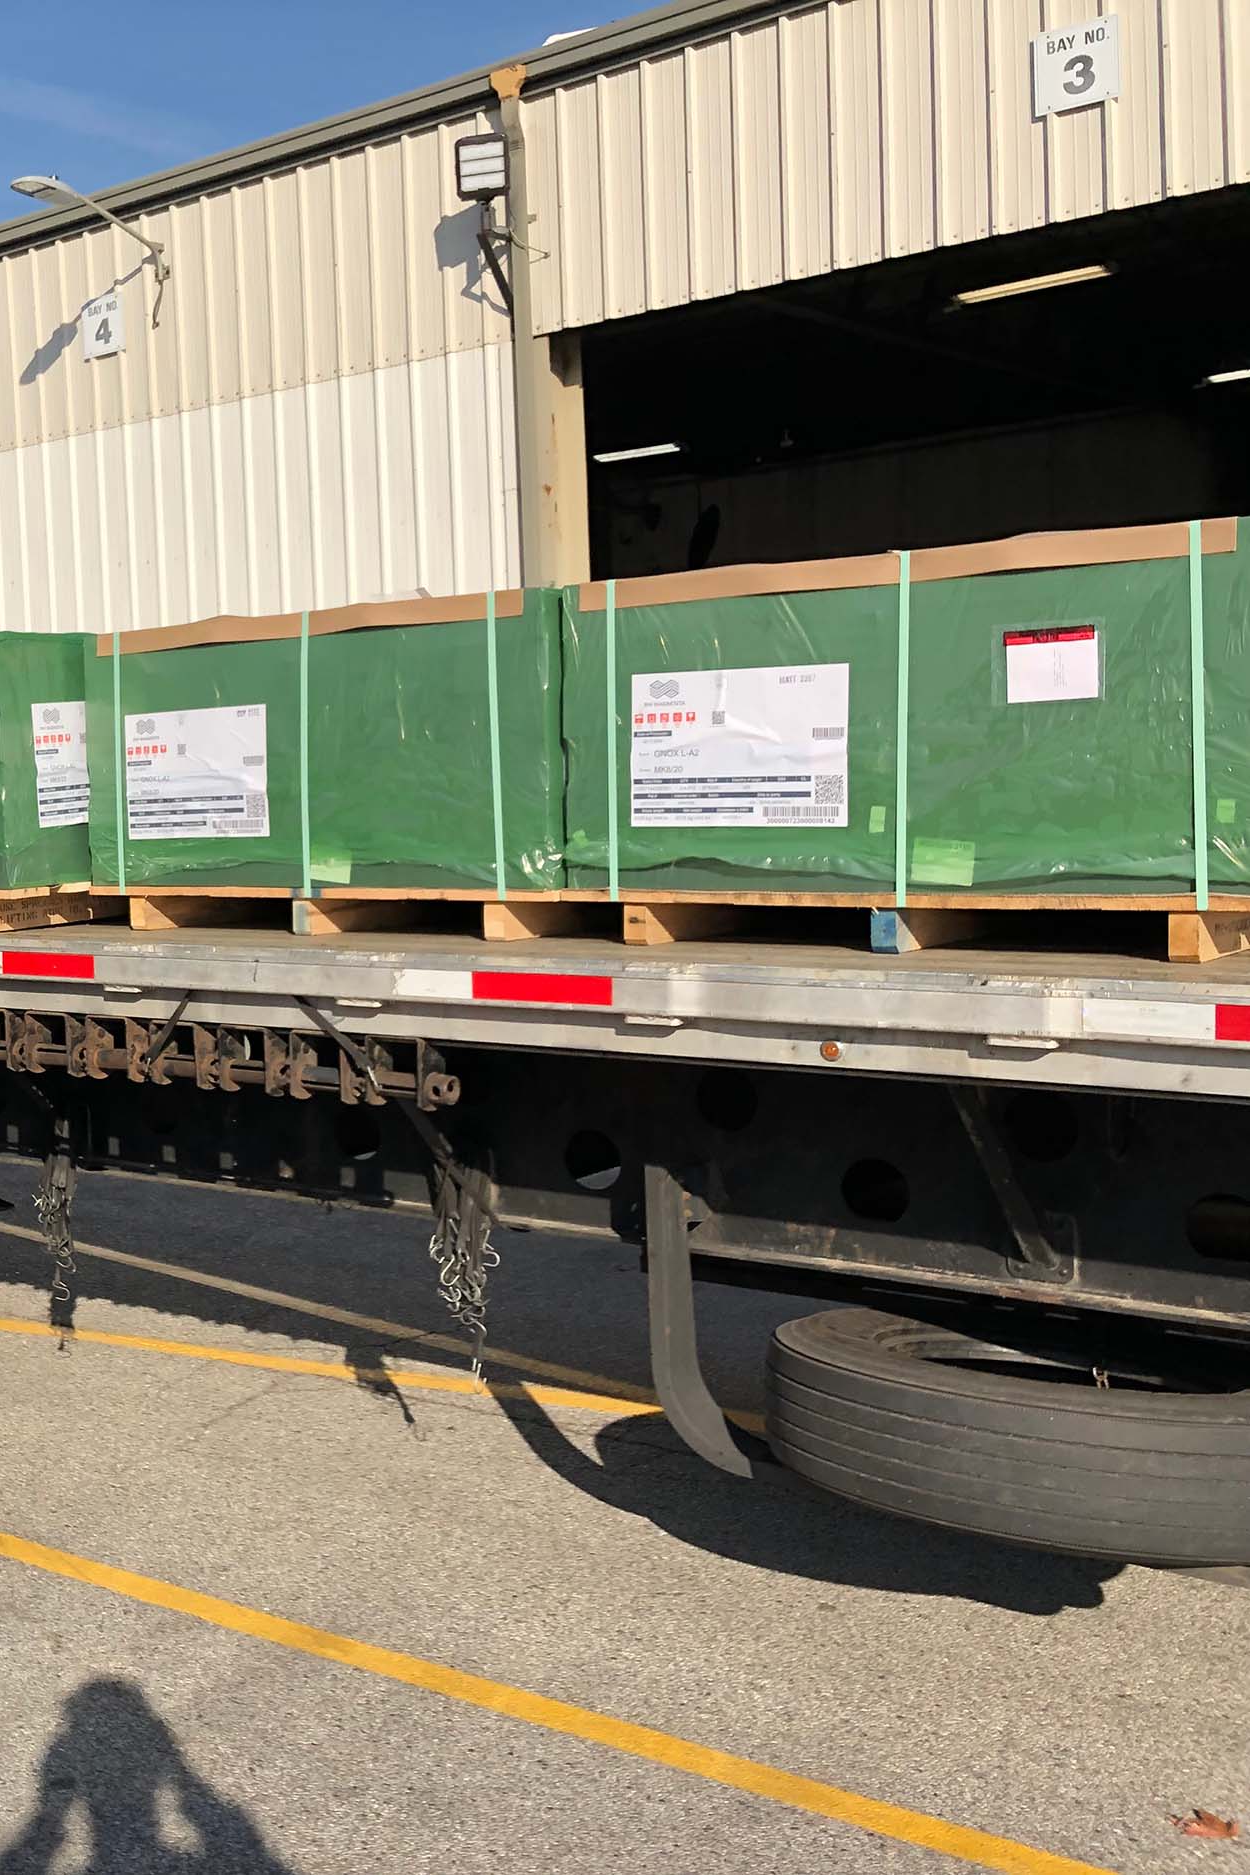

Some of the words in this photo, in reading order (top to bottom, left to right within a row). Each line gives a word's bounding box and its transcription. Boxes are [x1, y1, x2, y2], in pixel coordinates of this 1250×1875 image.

[1046, 35, 1076, 55] BAY
[1084, 27, 1110, 45] NO.
[1063, 54, 1096, 95] 3
[87, 304, 102, 317] BAY
[95, 317, 112, 345] 4
